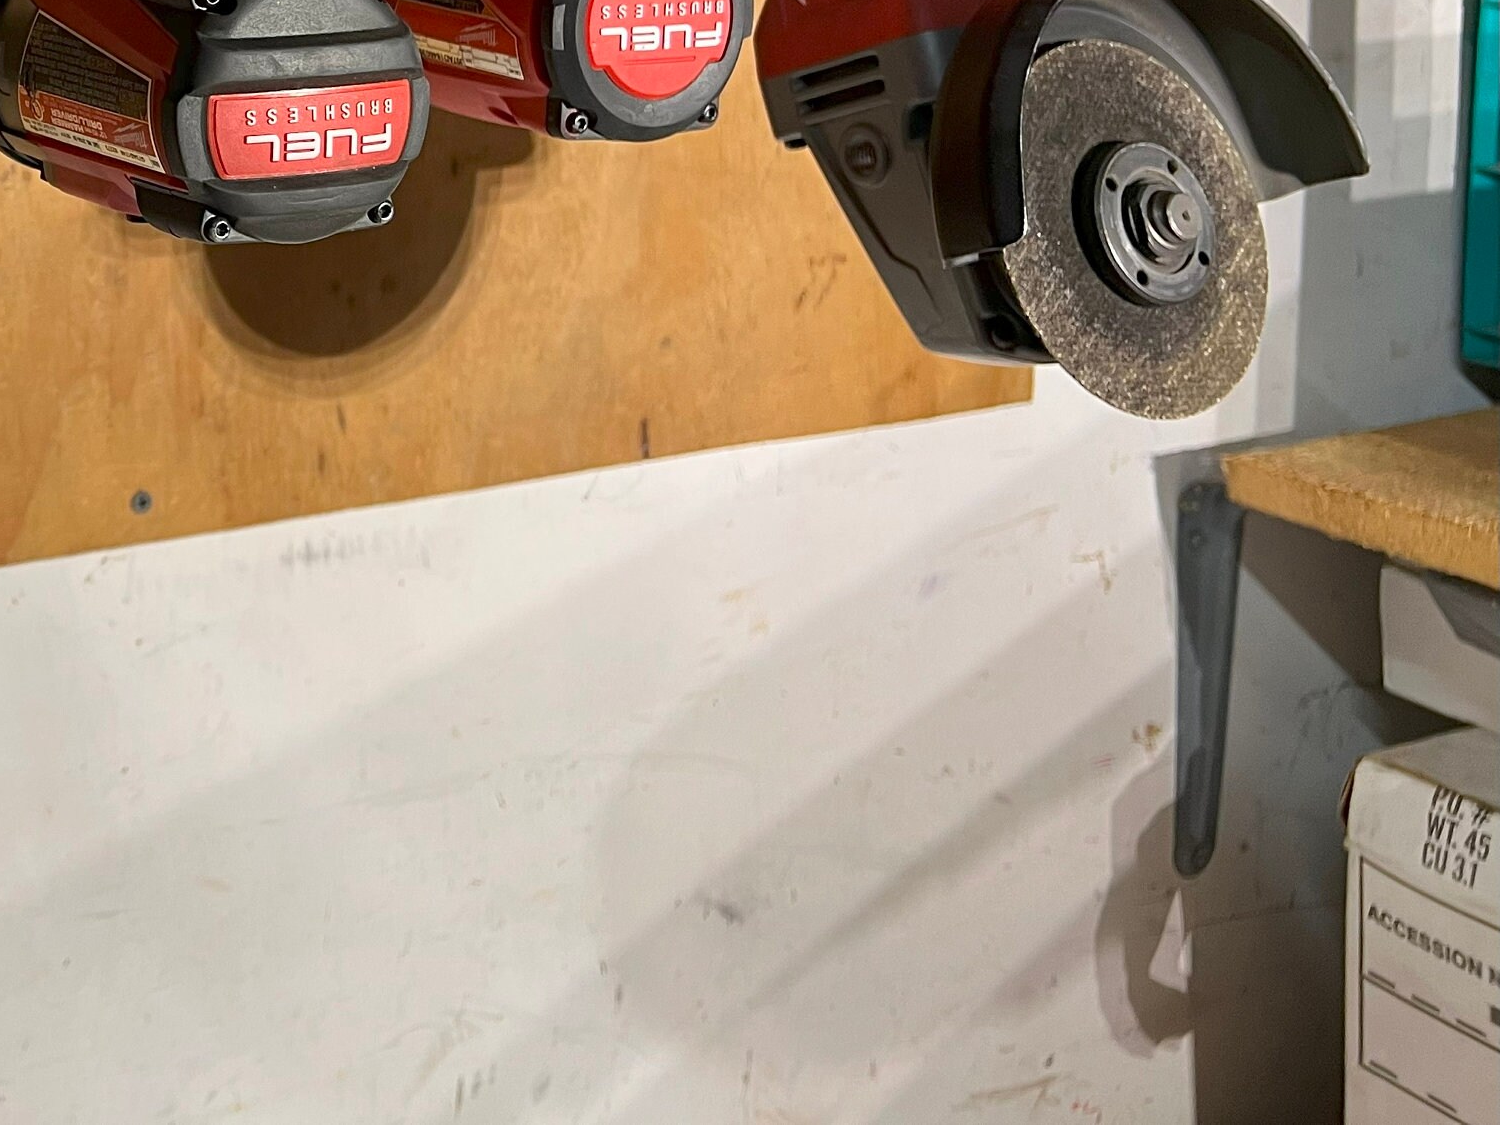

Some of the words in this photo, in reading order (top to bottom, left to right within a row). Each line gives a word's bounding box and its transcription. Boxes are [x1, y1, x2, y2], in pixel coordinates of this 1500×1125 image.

[602, 0, 724, 20] BRUSHLESS
[600, 22, 723, 52] FUEL
[245, 98, 393, 126] BRUSHLESS
[244, 123, 392, 162] FUEL
[1427, 812, 1458, 849] WT.
[1464, 829, 1493, 862] 45
[1421, 843, 1449, 875] CU
[1452, 854, 1478, 888] 3.1
[1368, 904, 1482, 979] ACCESSION
